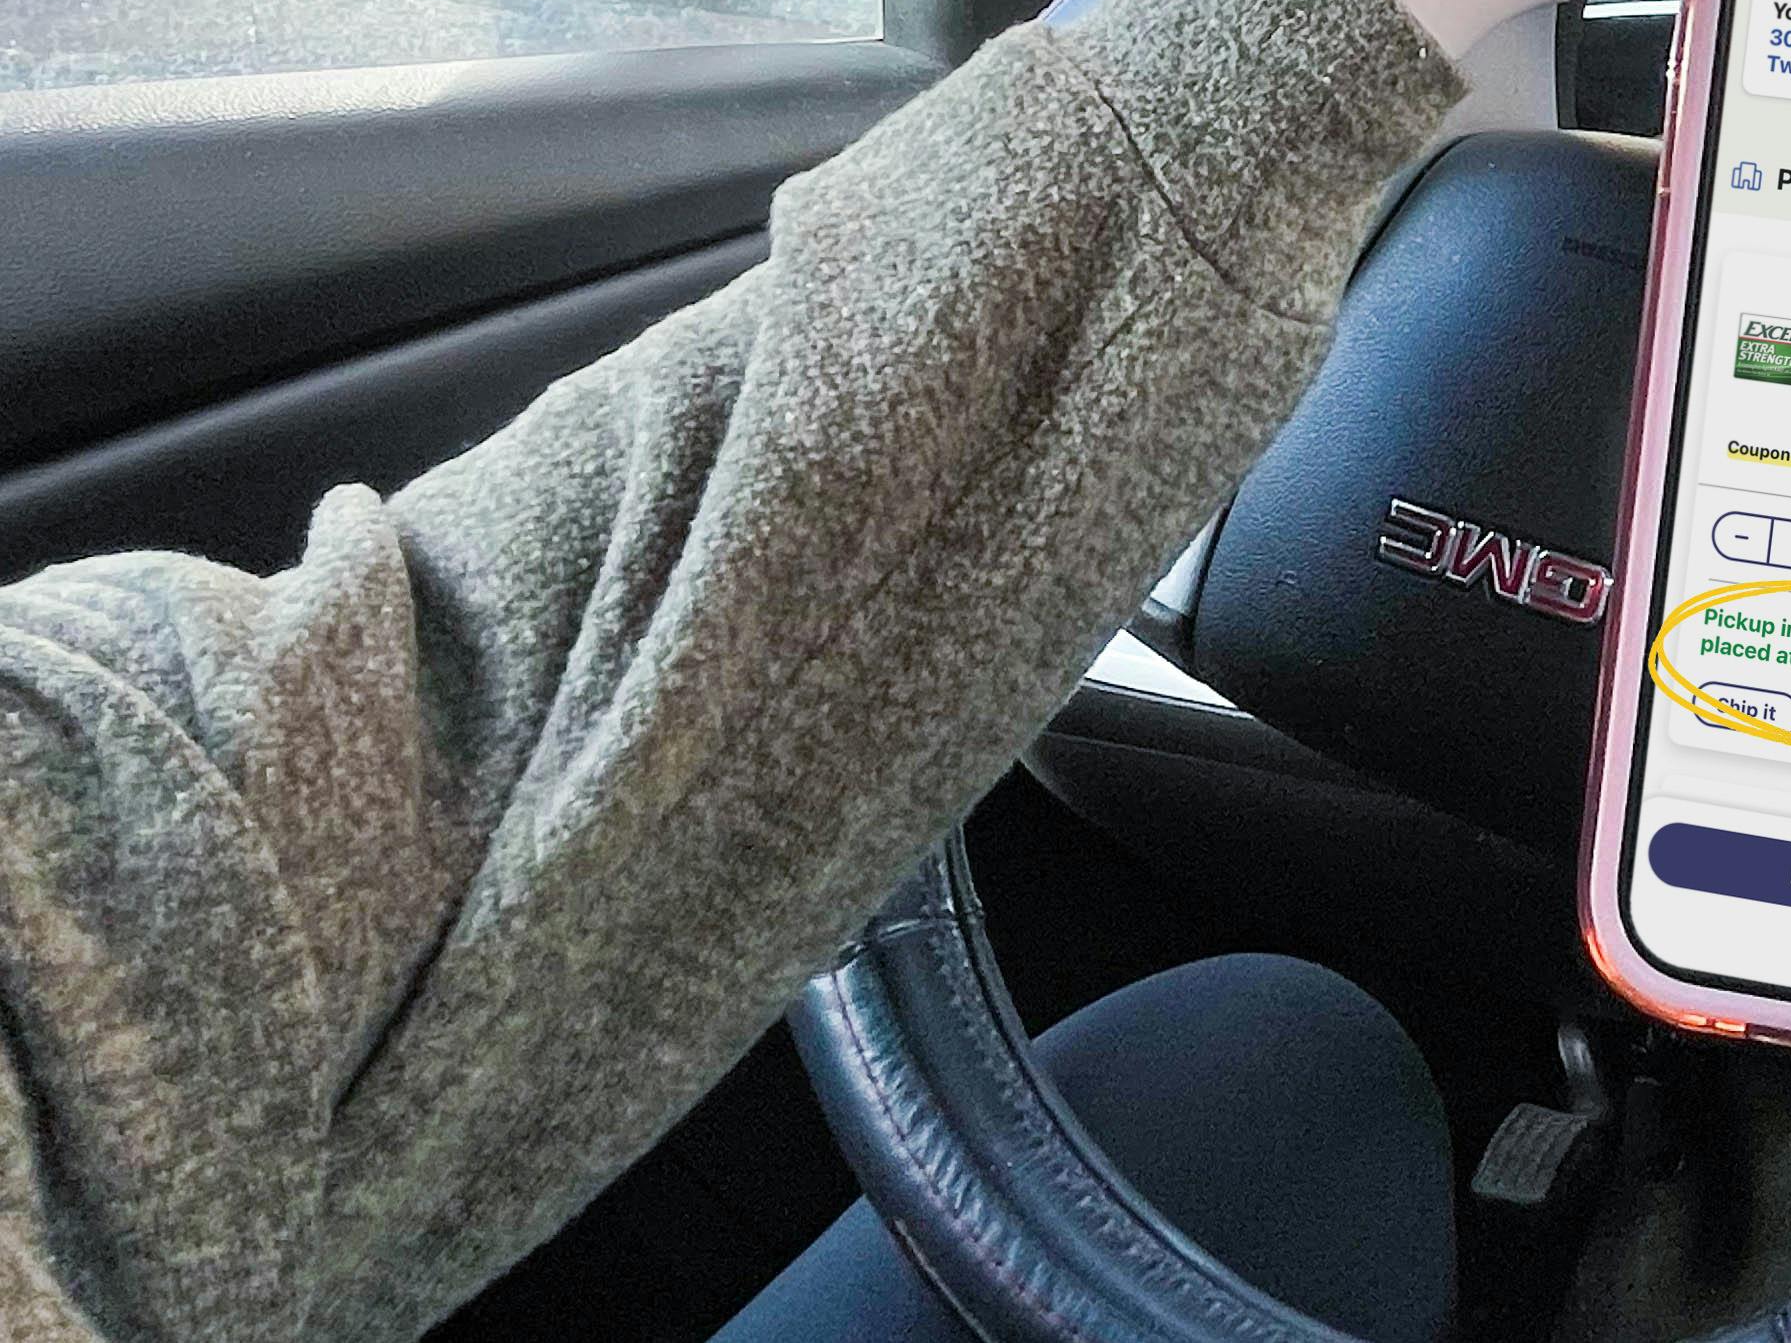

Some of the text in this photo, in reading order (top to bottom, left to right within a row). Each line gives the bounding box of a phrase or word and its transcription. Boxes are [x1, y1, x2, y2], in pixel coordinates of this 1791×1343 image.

[1740, 341, 1775, 354] EXTRA
[1727, 440, 1791, 462] Coupon
[1378, 498, 1614, 624] GMC
[1702, 607, 1776, 638] Pickup
[1700, 635, 1771, 662] placed
[1763, 703, 1777, 722] it
